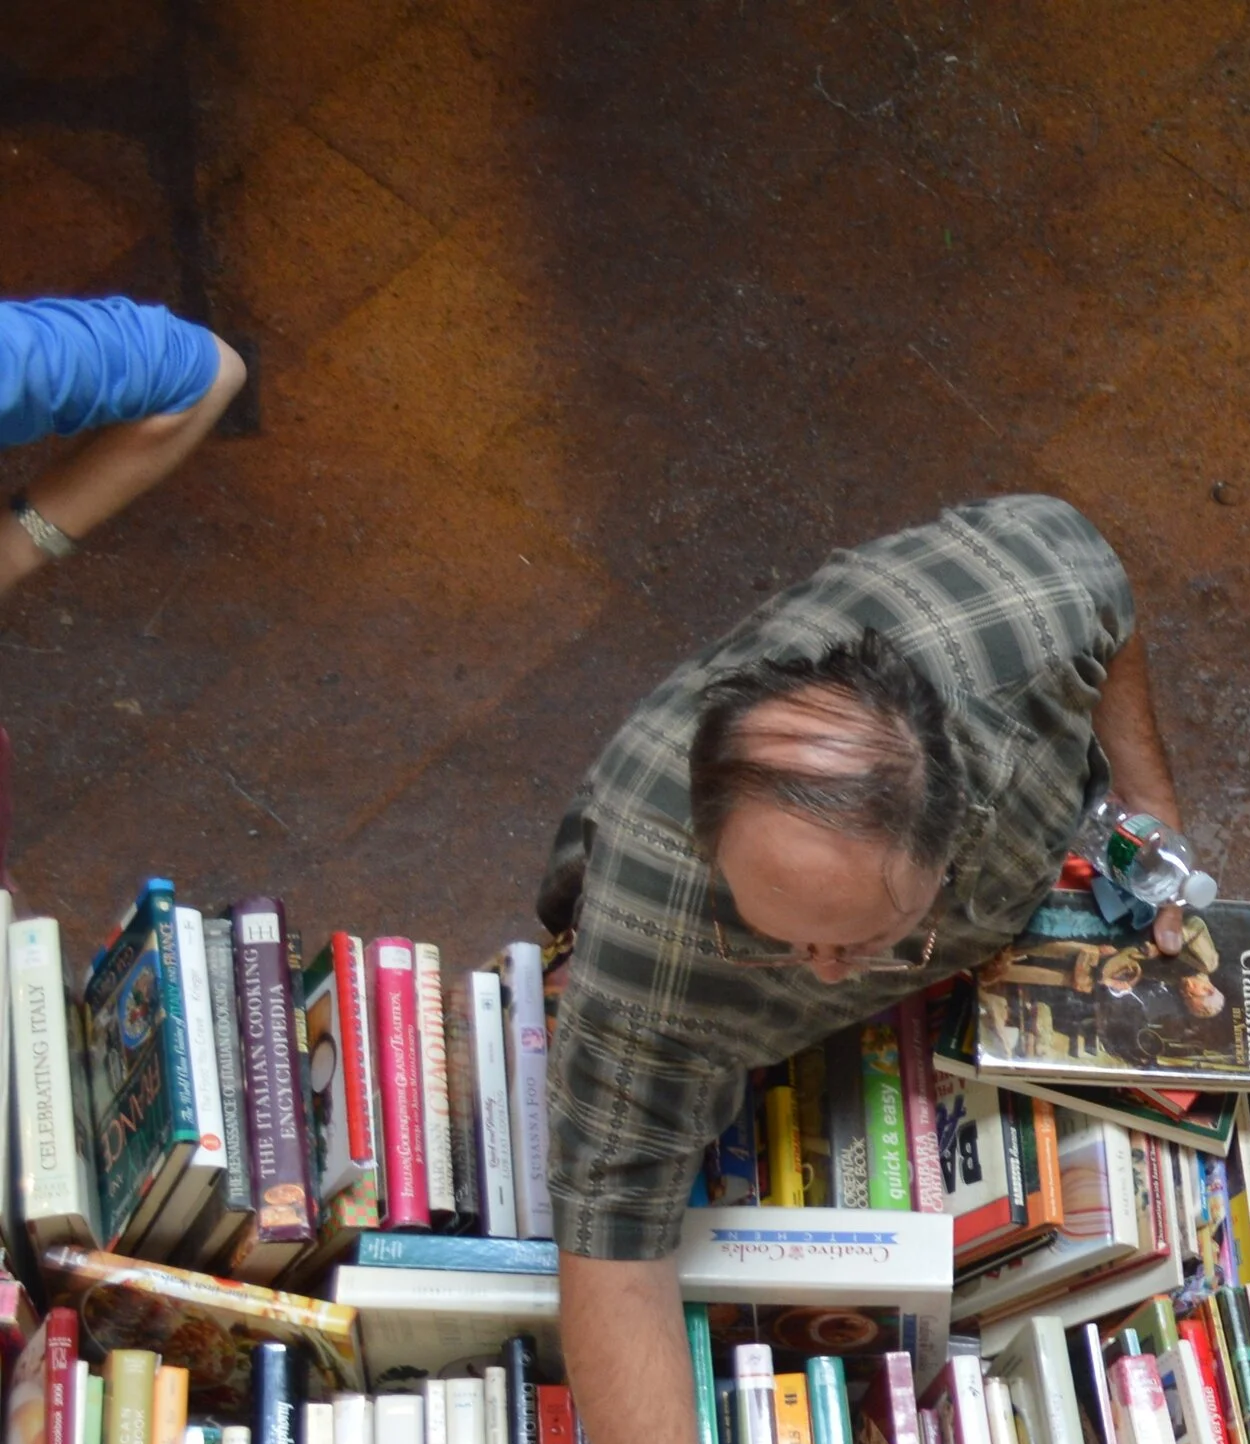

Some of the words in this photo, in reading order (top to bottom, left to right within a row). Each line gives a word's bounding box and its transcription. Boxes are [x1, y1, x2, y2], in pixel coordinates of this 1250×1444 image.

[25, 982, 47, 1034] ITALY
[242, 947, 264, 1038] COOKING
[265, 982, 299, 1139] ENCYCLOPEDIA
[30, 1039, 58, 1171] CELEBRATING
[249, 1043, 273, 1130] ITALIAN
[879, 1083, 901, 1126] easy
[257, 1136, 276, 1179] THE
[852, 1137, 866, 1176] BOOK
[883, 1131, 898, 1145] &
[841, 1146, 856, 1206] ORIENTAL
[854, 1179, 868, 1209] OOK
[883, 1150, 907, 1200] quick
[720, 1242, 784, 1262] Cook's
[807, 1244, 889, 1262] Creative
